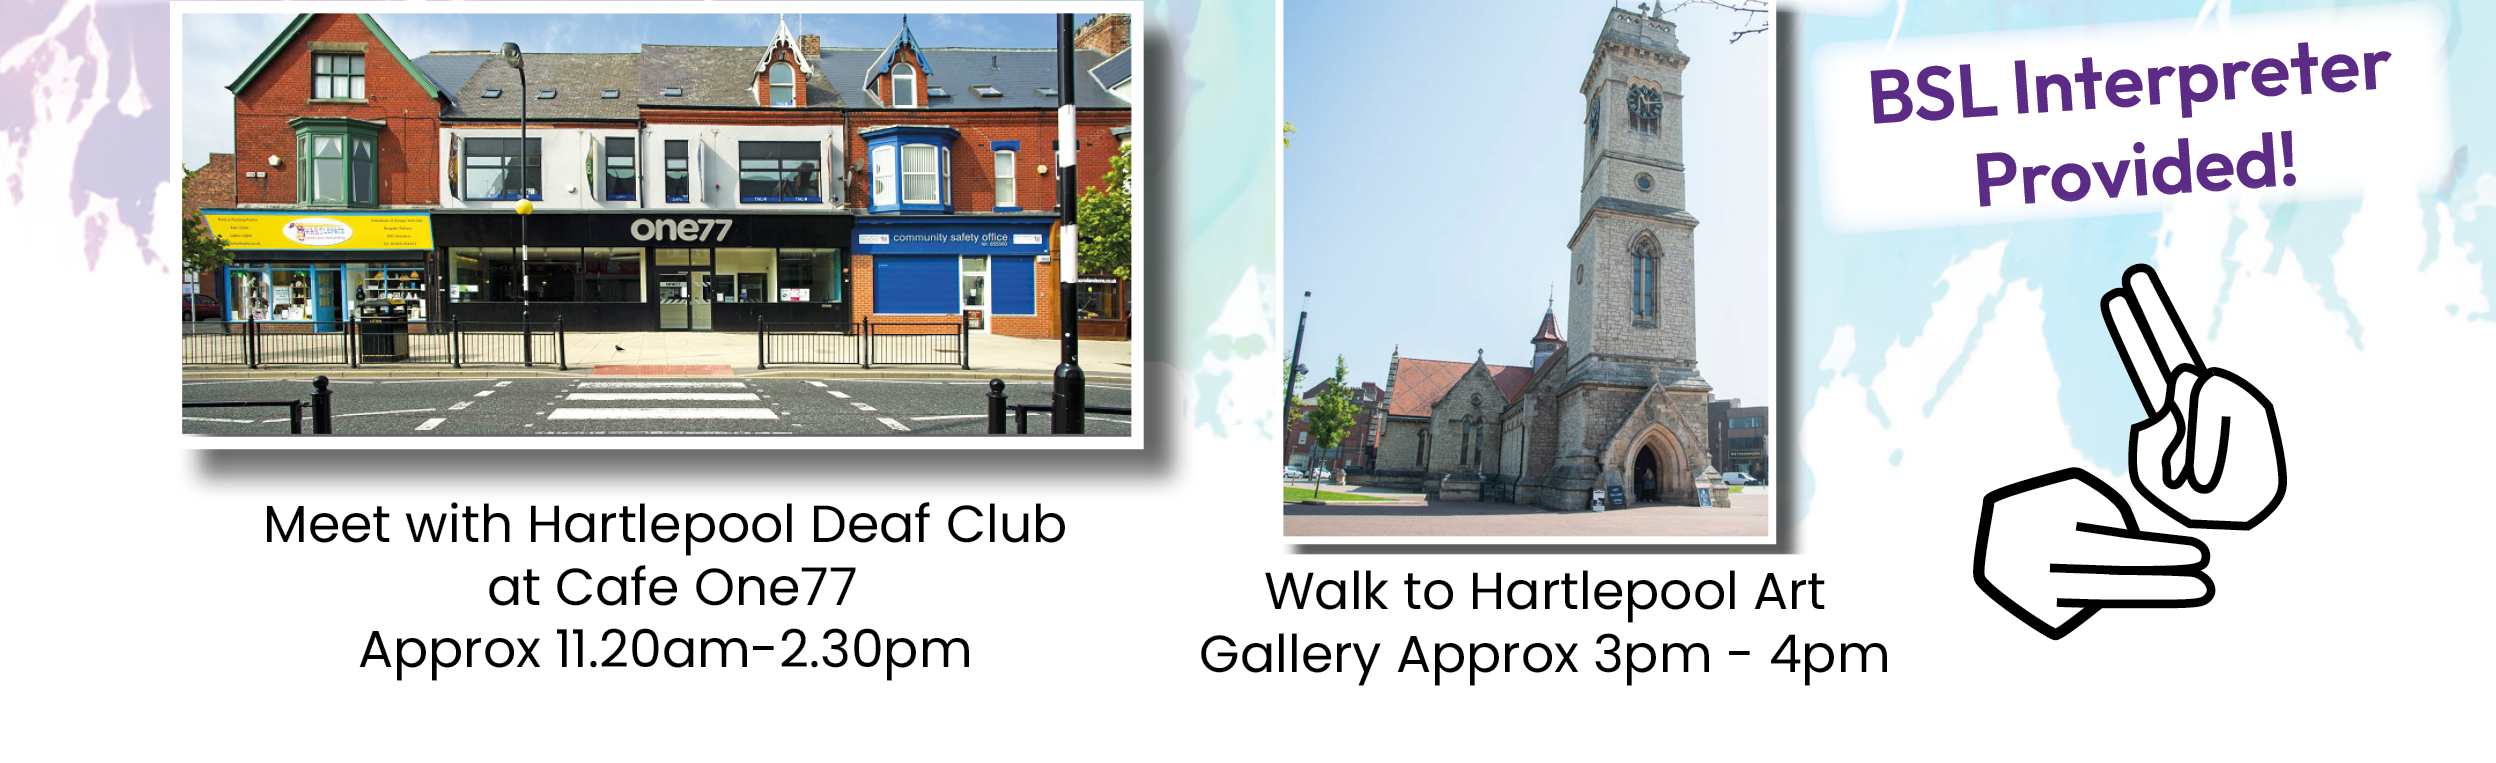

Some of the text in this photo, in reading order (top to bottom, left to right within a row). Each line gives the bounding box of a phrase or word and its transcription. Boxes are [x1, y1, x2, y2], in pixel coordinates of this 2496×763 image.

[631, 218, 733, 242] one77
[893, 232, 948, 244] community
[950, 232, 979, 244] safety
[982, 232, 1009, 242] office
